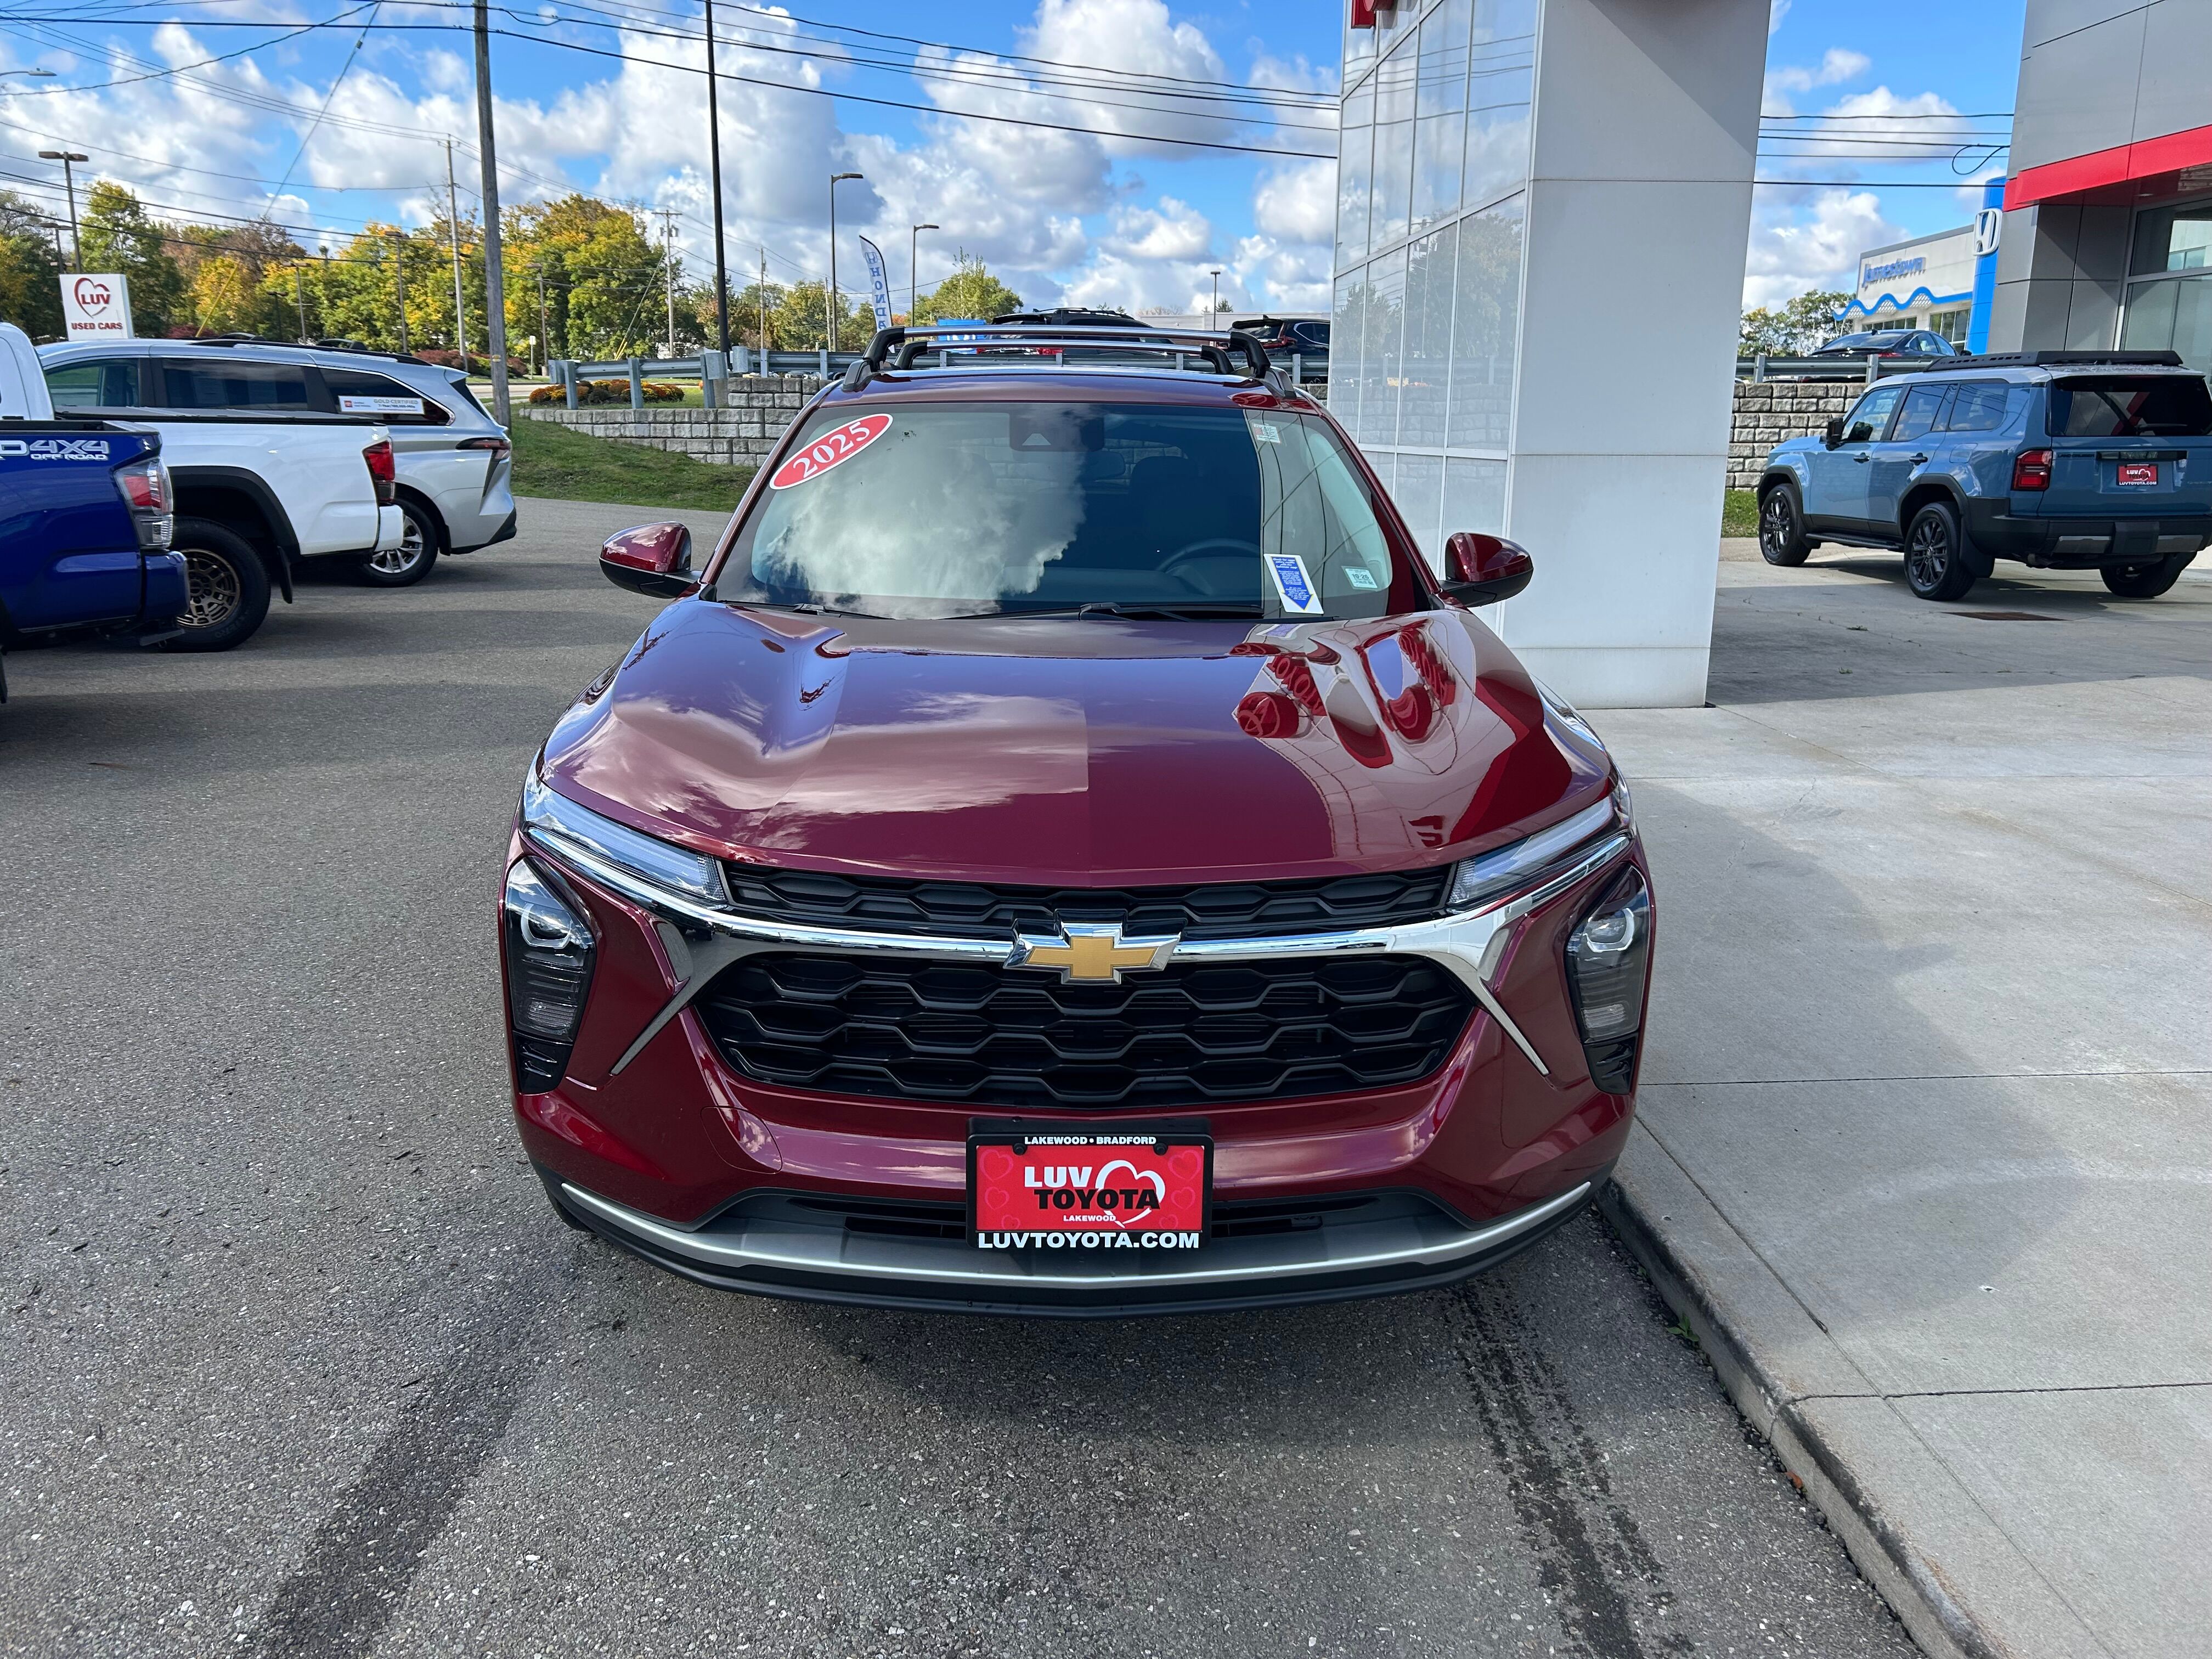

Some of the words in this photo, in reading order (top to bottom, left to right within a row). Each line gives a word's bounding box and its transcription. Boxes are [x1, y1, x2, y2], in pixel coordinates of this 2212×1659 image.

[81, 294, 110, 304] LUV
[793, 421, 870, 478] 2025
[1024, 1136, 1087, 1144] LAKEWOOD
[1096, 1136, 1156, 1144] BRADFORD
[1024, 1166, 1092, 1188] LUV
[1034, 1189, 1160, 1210] TOYOTA
[978, 1232, 1199, 1249] LUVTOYOTA.COM
